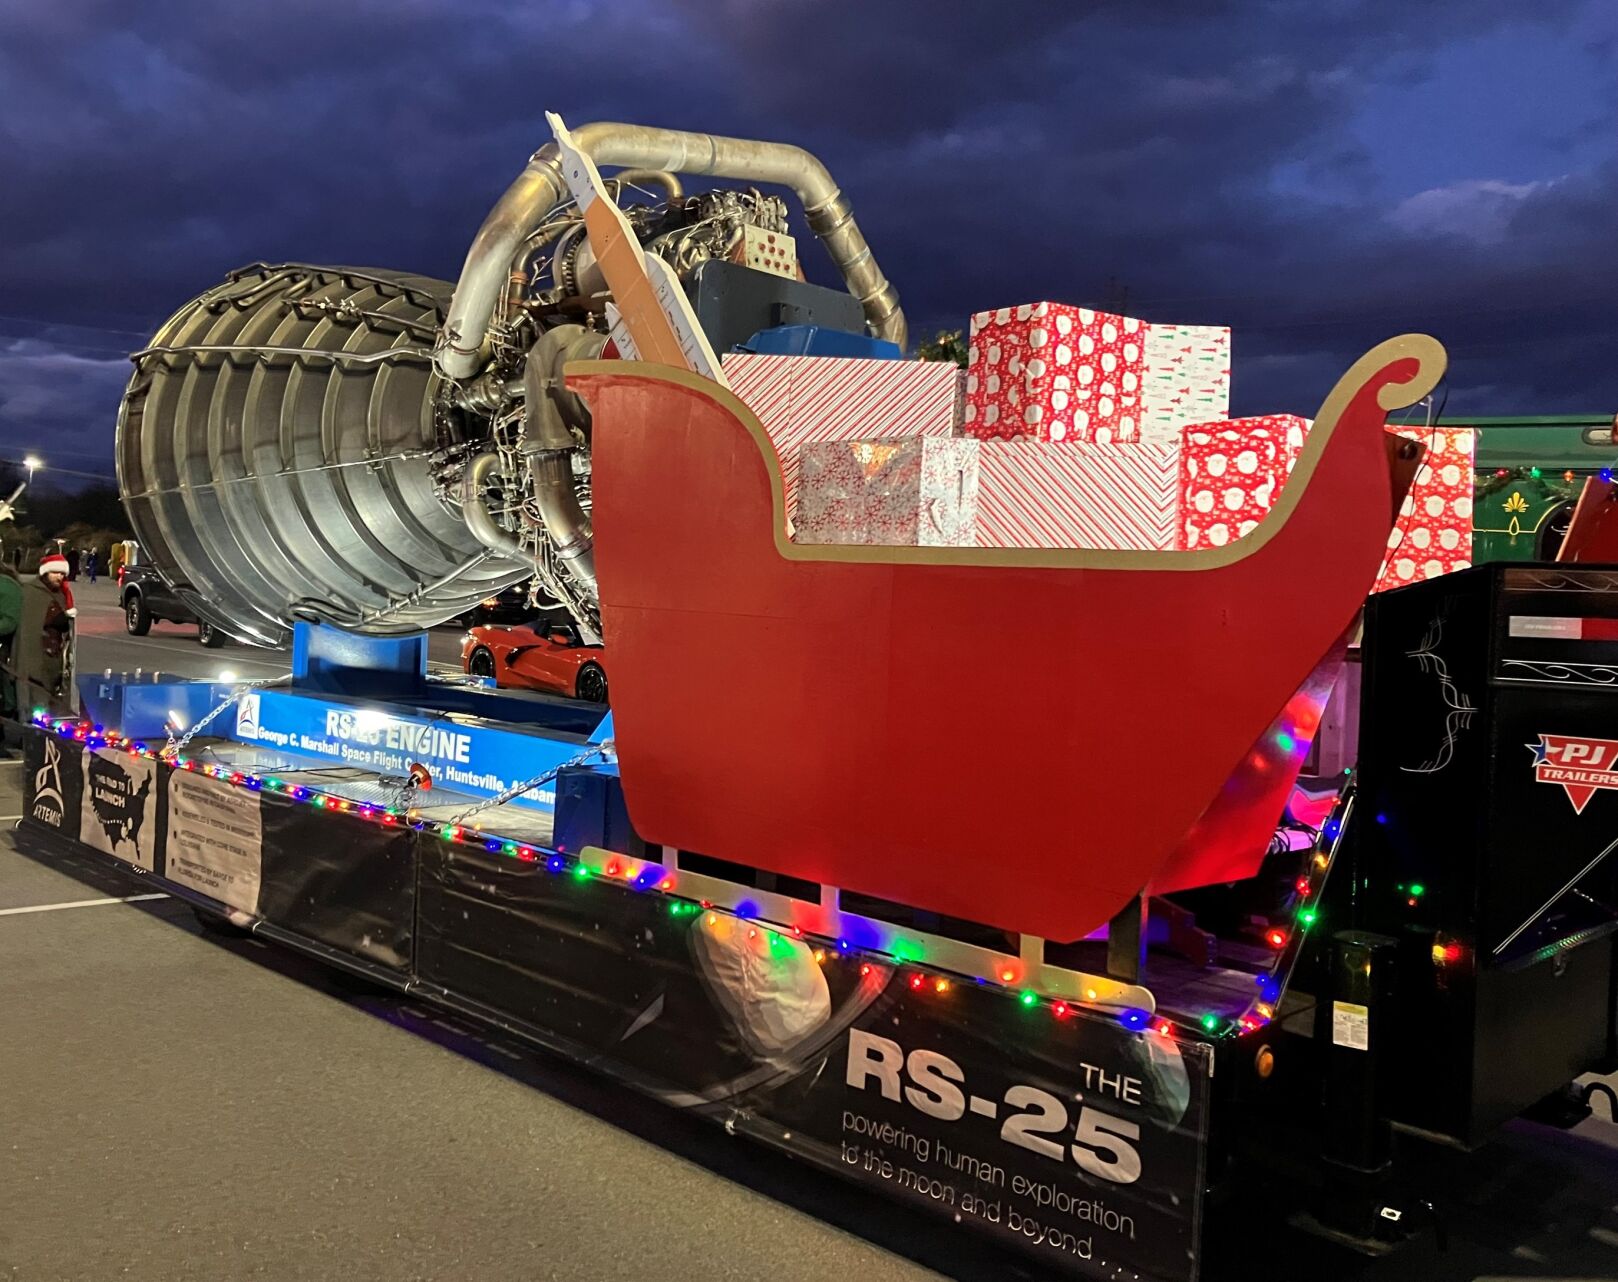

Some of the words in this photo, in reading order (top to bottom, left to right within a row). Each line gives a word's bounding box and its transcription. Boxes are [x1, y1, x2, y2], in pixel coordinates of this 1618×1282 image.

[386, 720, 471, 763] ENGINE
[1561, 743, 1606, 765] PJ
[258, 727, 288, 746] George
[290, 733, 299, 747] C.
[301, 735, 339, 755] Marshall
[341, 745, 371, 762] Space
[373, 750, 403, 771] Flight
[404, 757, 443, 781] Cter,
[445, 765, 508, 793] Huntsville,
[511, 780, 556, 805] Aabam
[1543, 768, 1618, 785] TRAILERS
[33, 805, 61, 828] ARTEMIS
[95, 787, 126, 809] LAUNCH
[1080, 1062, 1142, 1106] THE
[846, 1028, 1142, 1184] RS-25
[843, 1109, 929, 1162] powering
[935, 1138, 1006, 1188] human
[1012, 1172, 1136, 1240] exploration
[840, 1140, 858, 1165] to
[864, 1145, 893, 1180] the
[898, 1168, 956, 1207] moon
[961, 1186, 1000, 1224] and
[1008, 1209, 1092, 1261] beyond
